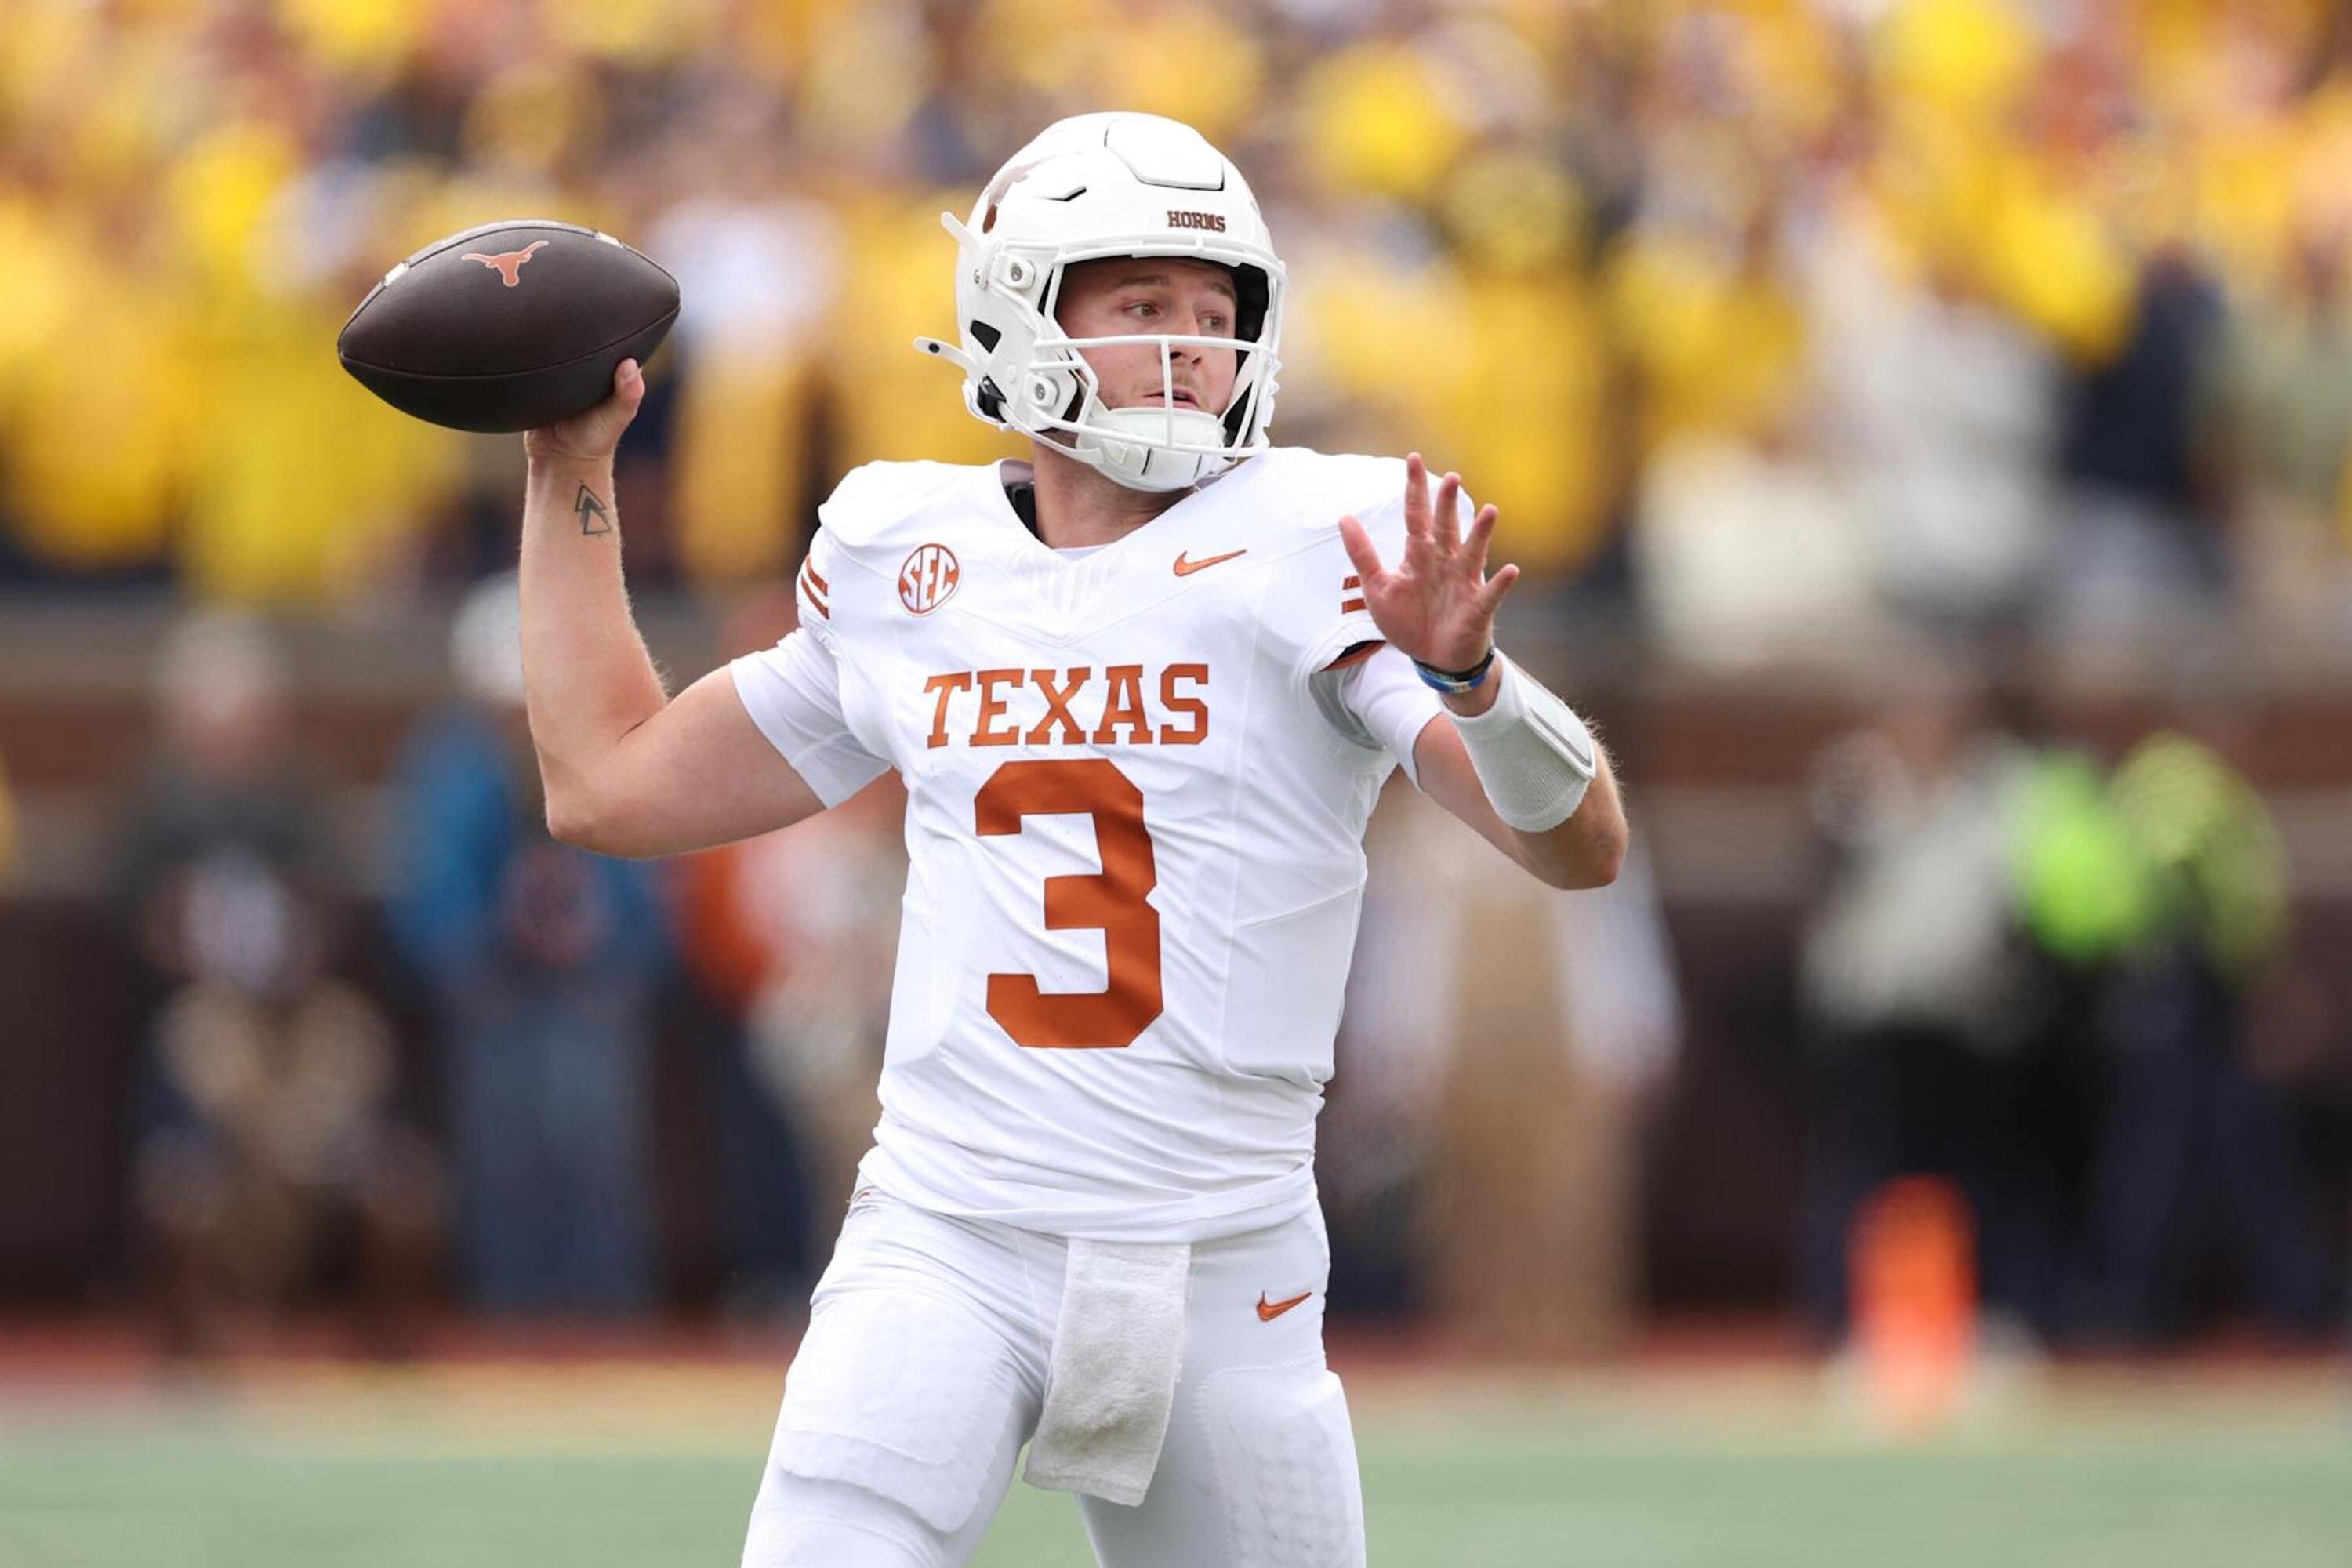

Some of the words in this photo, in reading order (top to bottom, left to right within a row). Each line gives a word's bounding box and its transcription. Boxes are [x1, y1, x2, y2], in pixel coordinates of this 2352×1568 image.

[1167, 210, 1226, 233] HORNS
[899, 545, 958, 613] SEC
[924, 663, 1209, 749] TEXAS
[974, 758, 1163, 1048] 3
